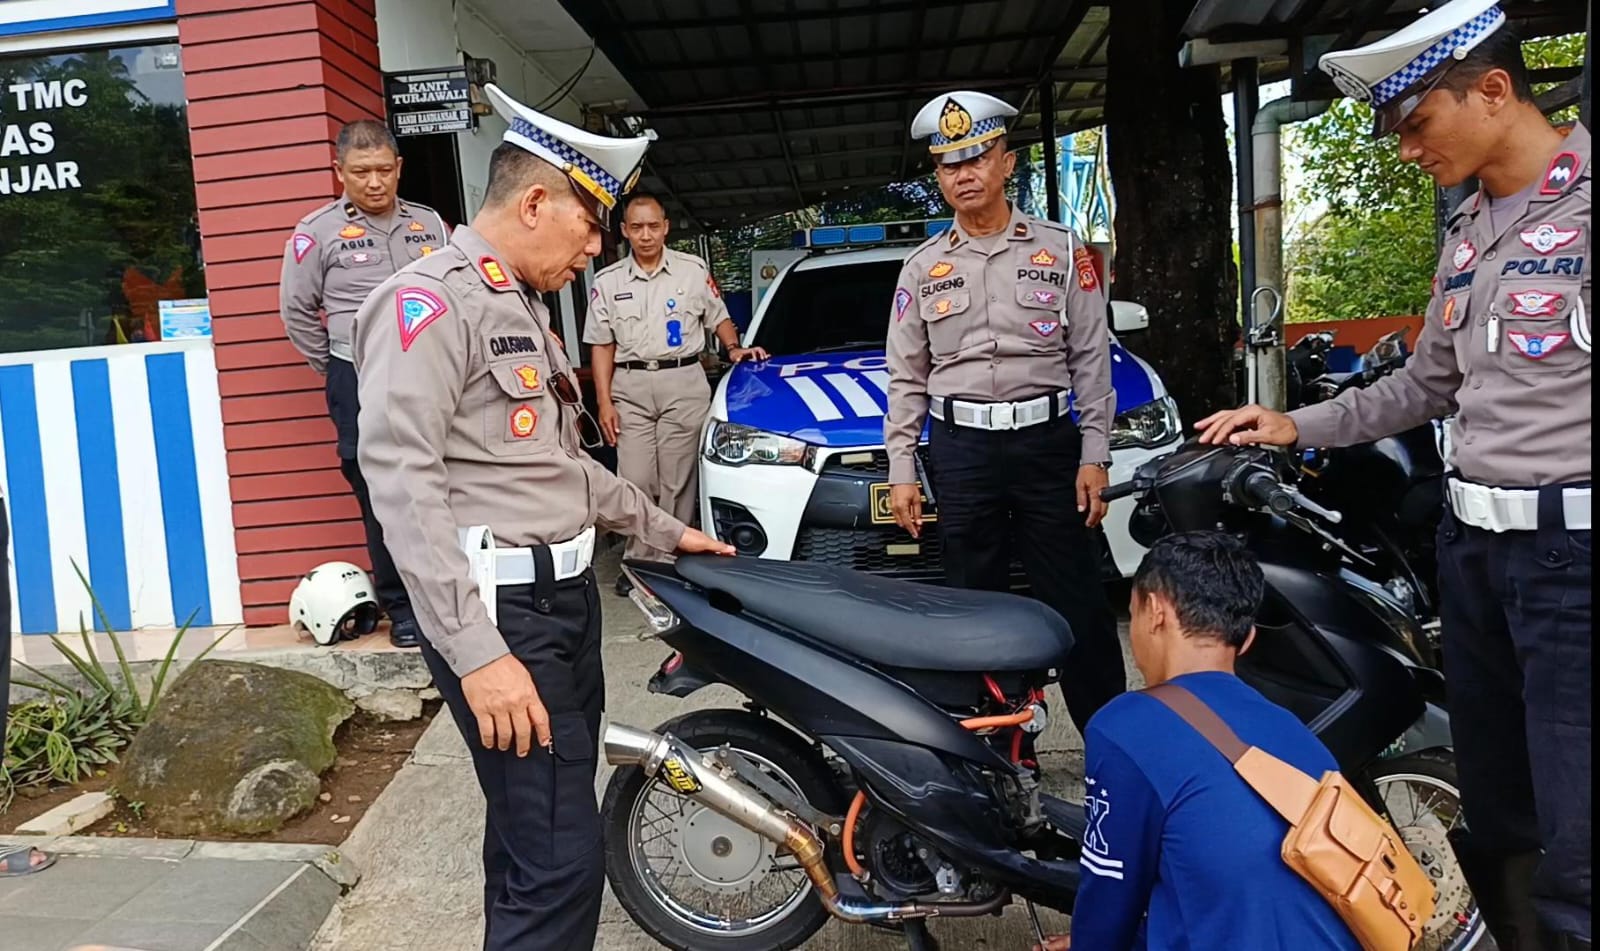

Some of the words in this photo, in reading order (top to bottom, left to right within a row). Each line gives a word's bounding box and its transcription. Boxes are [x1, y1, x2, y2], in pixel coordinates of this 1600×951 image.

[9, 78, 88, 111] TMC
[392, 89, 467, 104] TURJAWALI
[408, 81, 450, 93] KANIT
[0, 122, 55, 157] AS
[340, 238, 374, 250] AGUS
[404, 234, 436, 244] POLRI
[1501, 256, 1584, 276] POLRI
[921, 276, 964, 298] SUGENG
[1017, 268, 1065, 287] POLRI
